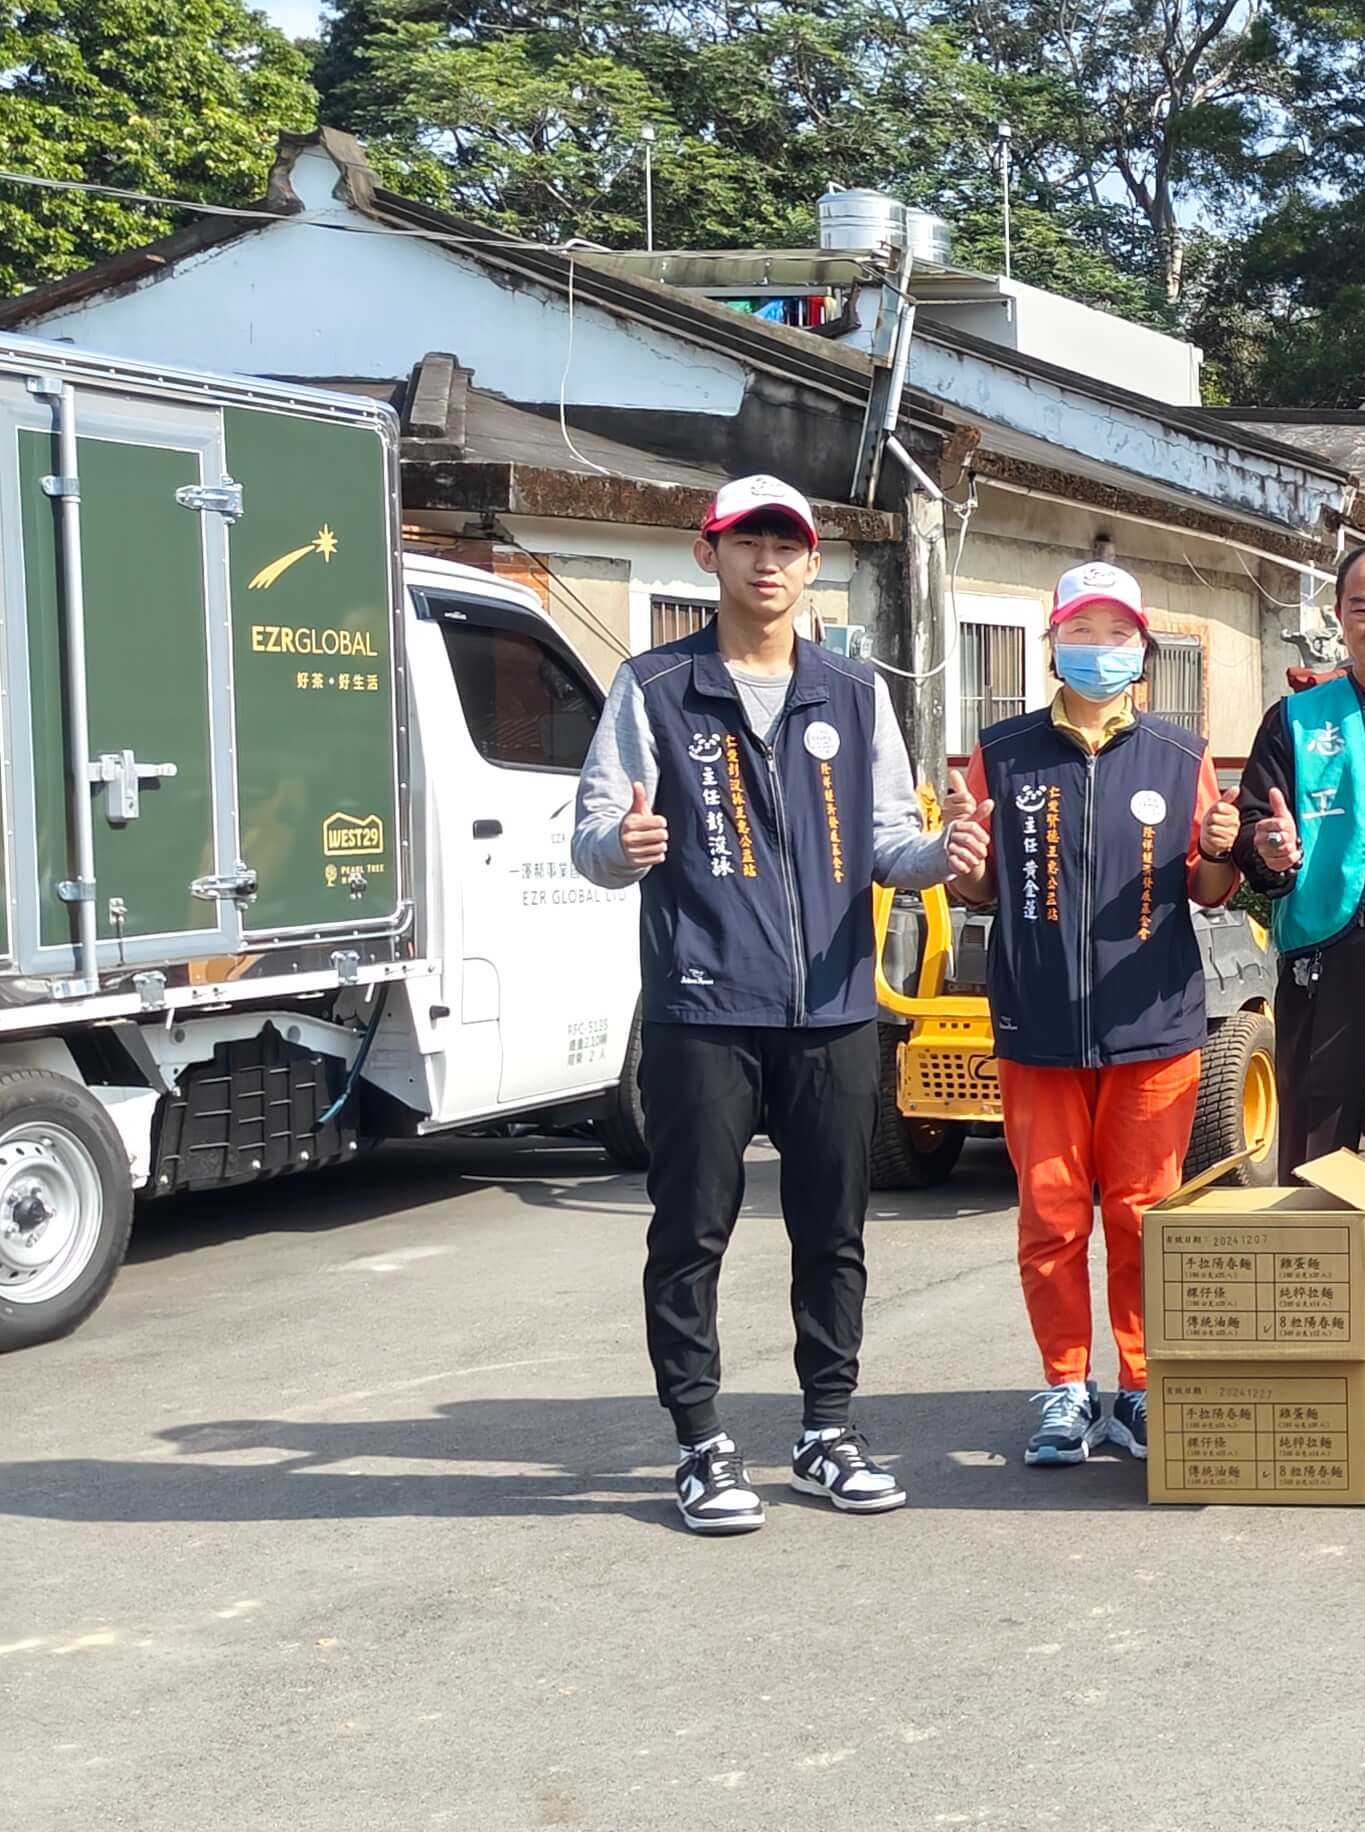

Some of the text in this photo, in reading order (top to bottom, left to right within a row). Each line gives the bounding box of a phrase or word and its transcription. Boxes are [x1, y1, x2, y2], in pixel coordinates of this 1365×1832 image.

[251, 625, 378, 656] EZRGLOBAL
[328, 828, 379, 849] WEST29
[522, 890, 547, 906] EZR
[552, 889, 601, 905] GLOBAL
